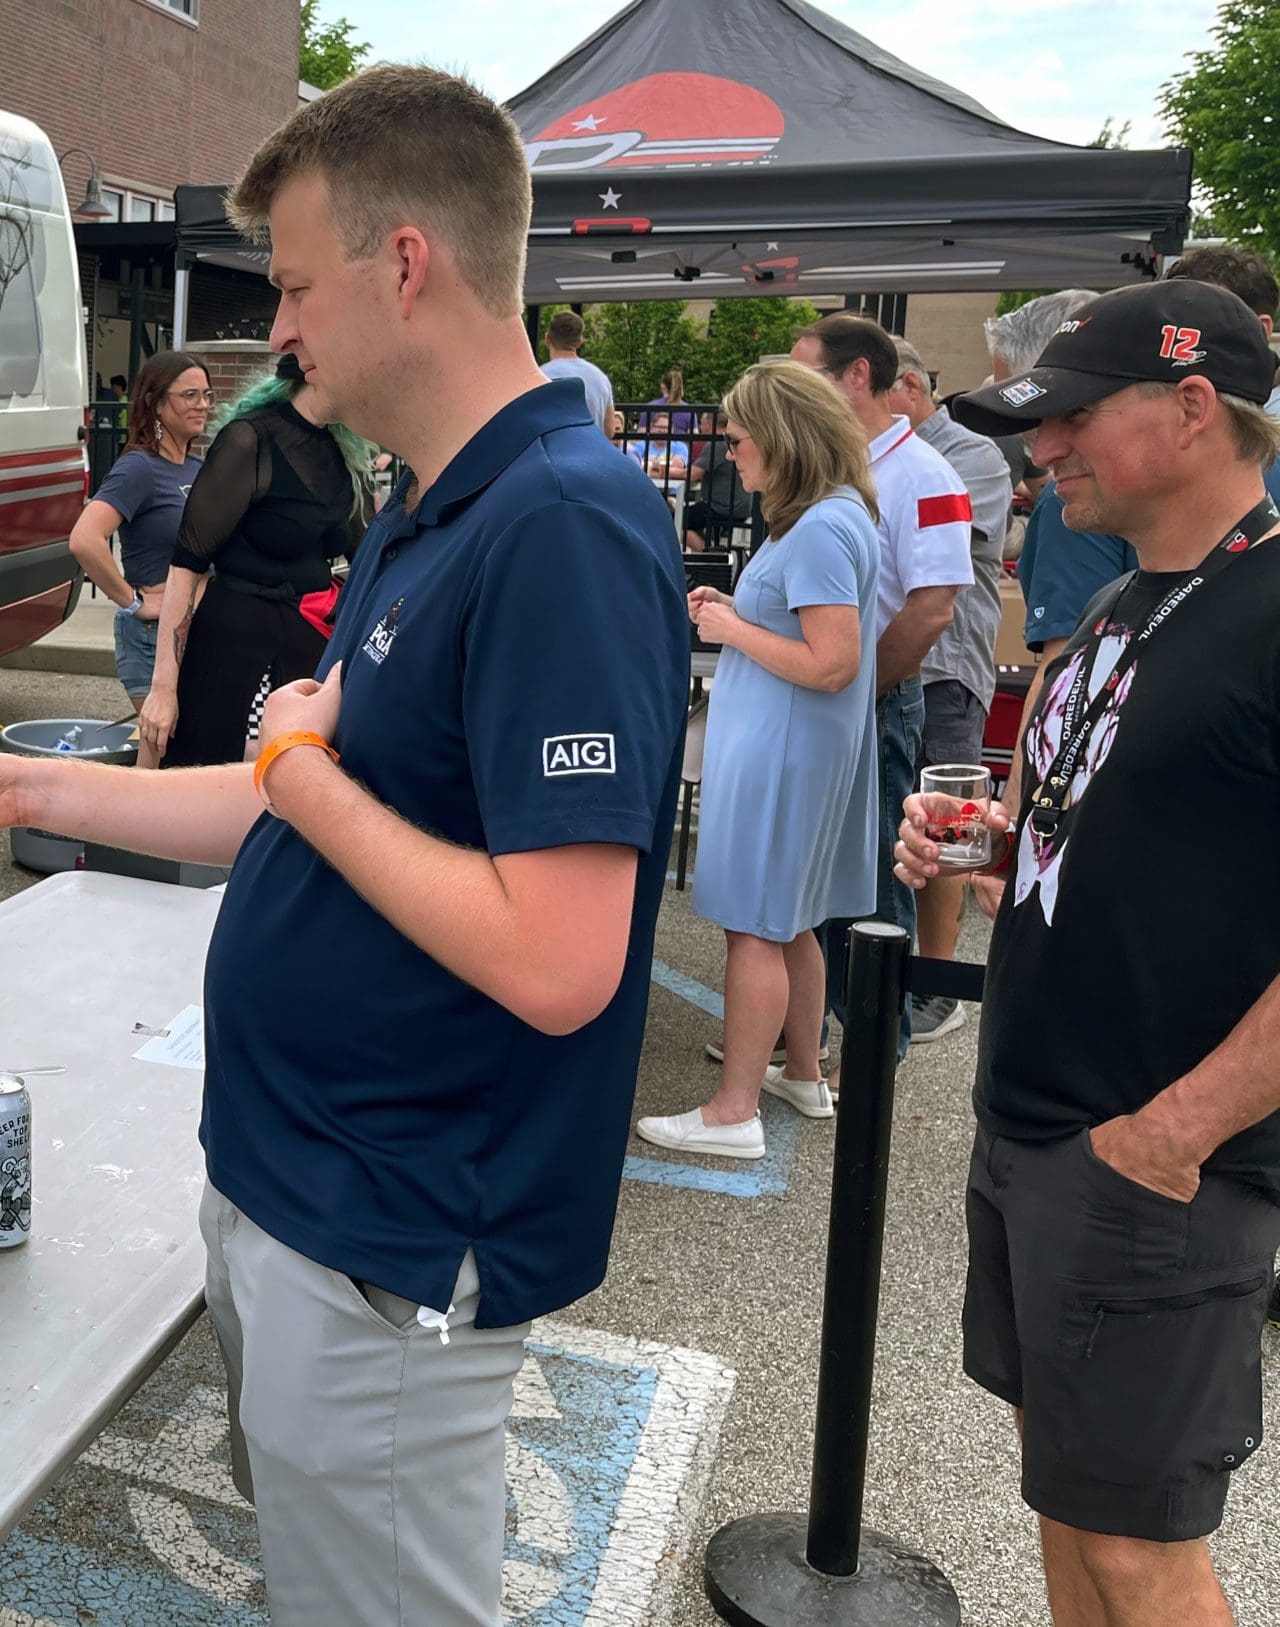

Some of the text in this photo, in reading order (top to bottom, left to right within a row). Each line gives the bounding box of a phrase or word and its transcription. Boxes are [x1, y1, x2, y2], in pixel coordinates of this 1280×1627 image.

[1160, 324, 1201, 361] 12
[1138, 576, 1204, 641] DAREDEVIL
[369, 623, 394, 656] PGA
[1063, 666, 1087, 741] DAREDEVIL
[549, 741, 607, 769] AIG
